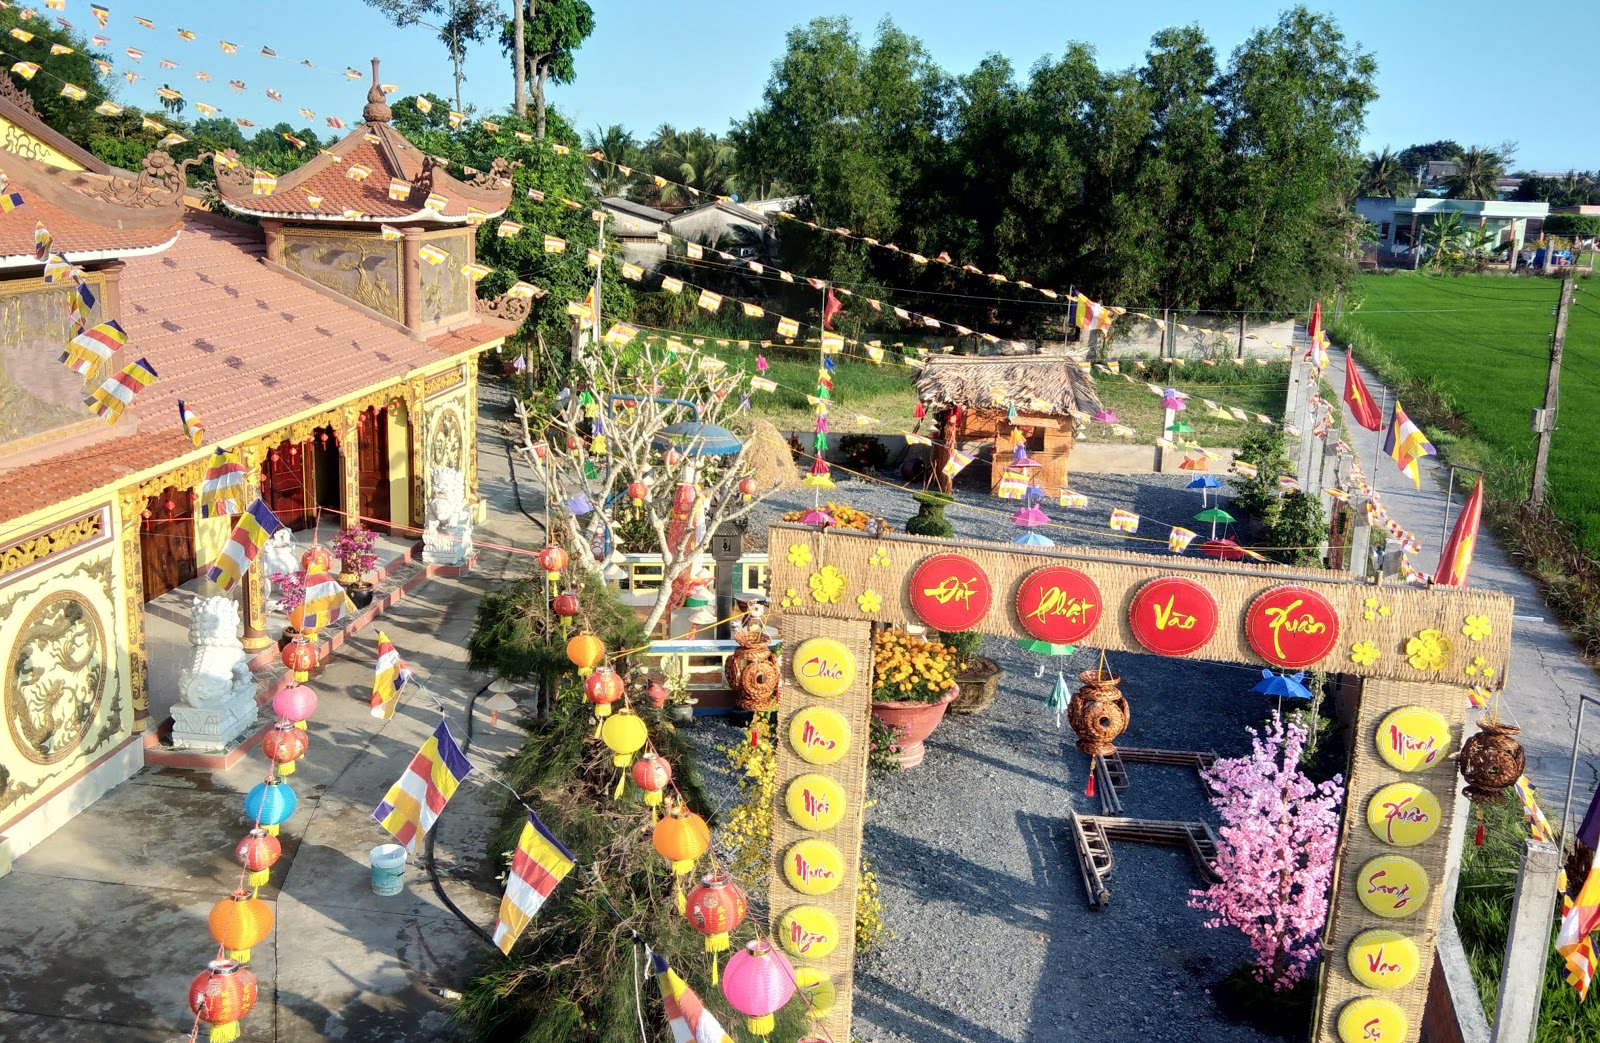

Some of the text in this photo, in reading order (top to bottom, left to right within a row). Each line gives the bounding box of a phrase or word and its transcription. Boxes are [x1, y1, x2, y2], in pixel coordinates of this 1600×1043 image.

[1025, 586, 1096, 625] Phật
[1153, 591, 1198, 630] Vào
[1264, 599, 1326, 660] Xuân
[801, 656, 845, 680] Chúc
[1382, 797, 1429, 843] Xuân
[1367, 870, 1411, 909] Sang
[1366, 944, 1402, 976] Vạn
